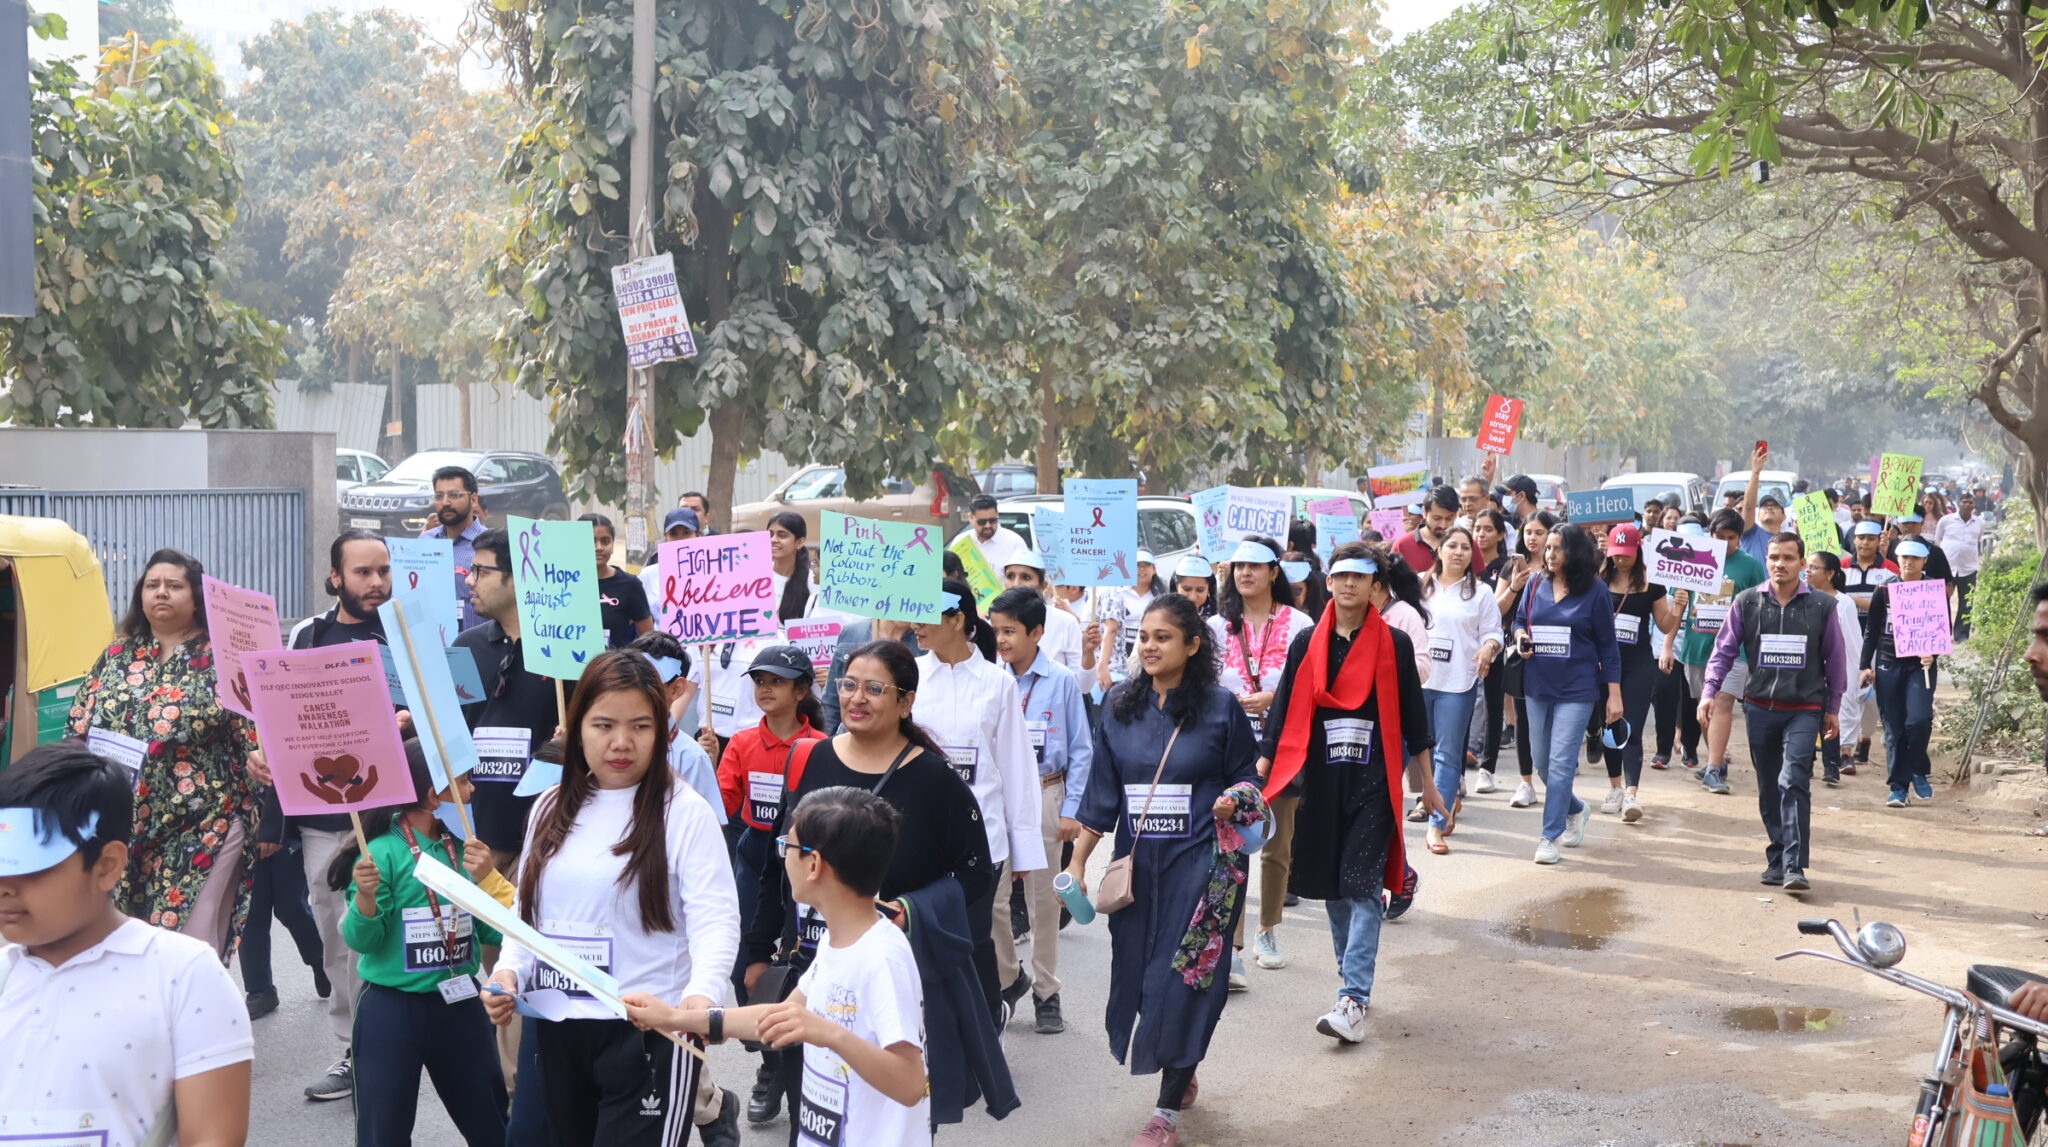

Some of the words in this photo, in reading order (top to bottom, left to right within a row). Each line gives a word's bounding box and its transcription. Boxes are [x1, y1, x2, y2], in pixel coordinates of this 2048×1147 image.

[646, 273, 675, 288] 39080
[621, 306, 636, 318] LOW
[637, 301, 657, 313] PRICE
[1495, 412, 1510, 422] stay
[1489, 421, 1512, 433] strong
[1488, 433, 1505, 444] beat
[1482, 443, 1507, 454] cancer
[1882, 456, 1921, 474] BRAVE
[1568, 500, 1582, 517] Be
[1585, 502, 1593, 515] a
[1595, 496, 1633, 514] Hero.
[1228, 504, 1286, 537] CANCER
[844, 517, 886, 545] Pink
[823, 538, 844, 554] Not
[848, 542, 877, 559] Just
[881, 545, 905, 560] the
[1071, 548, 1106, 556] CANCER!
[677, 545, 740, 579] FIGHT
[831, 555, 875, 572] Colour
[881, 560, 900, 578] of
[903, 564, 916, 577] a
[1657, 559, 1714, 580] STRONG
[544, 563, 581, 592] Hope
[1655, 571, 1684, 582] AGAINST
[1685, 577, 1713, 587] CANCER
[678, 574, 772, 608] believe
[1894, 583, 1943, 597] Together
[524, 587, 573, 618] against
[834, 590, 870, 608] Power
[875, 594, 894, 617] of
[900, 598, 935, 618] Hope
[1900, 600, 1913, 610] We
[1919, 600, 1936, 609] are
[534, 614, 587, 640] Cancer
[668, 608, 761, 640] SURVIE
[1897, 611, 1944, 627] Tougher
[801, 624, 830, 634] HELLO
[1898, 638, 1947, 654] CANCER
[325, 661, 341, 670] DLF
[1763, 654, 1802, 665] 1603288
[260, 684, 274, 692] DLF
[291, 679, 340, 690] INNOVATIVE
[340, 675, 372, 685] SCHOOL
[290, 691, 314, 700] RIDGE
[314, 688, 344, 698] VALLEY
[303, 702, 337, 713] CANCER
[297, 710, 349, 722] AWARENESS
[299, 718, 352, 731] WALKATHON
[296, 734, 317, 742] CAN'T
[301, 741, 336, 750] EVERYONE
[353, 737, 370, 746] HELP
[314, 749, 346, 757] SOMEONE
[814, 1091, 839, 1107] CANCER
